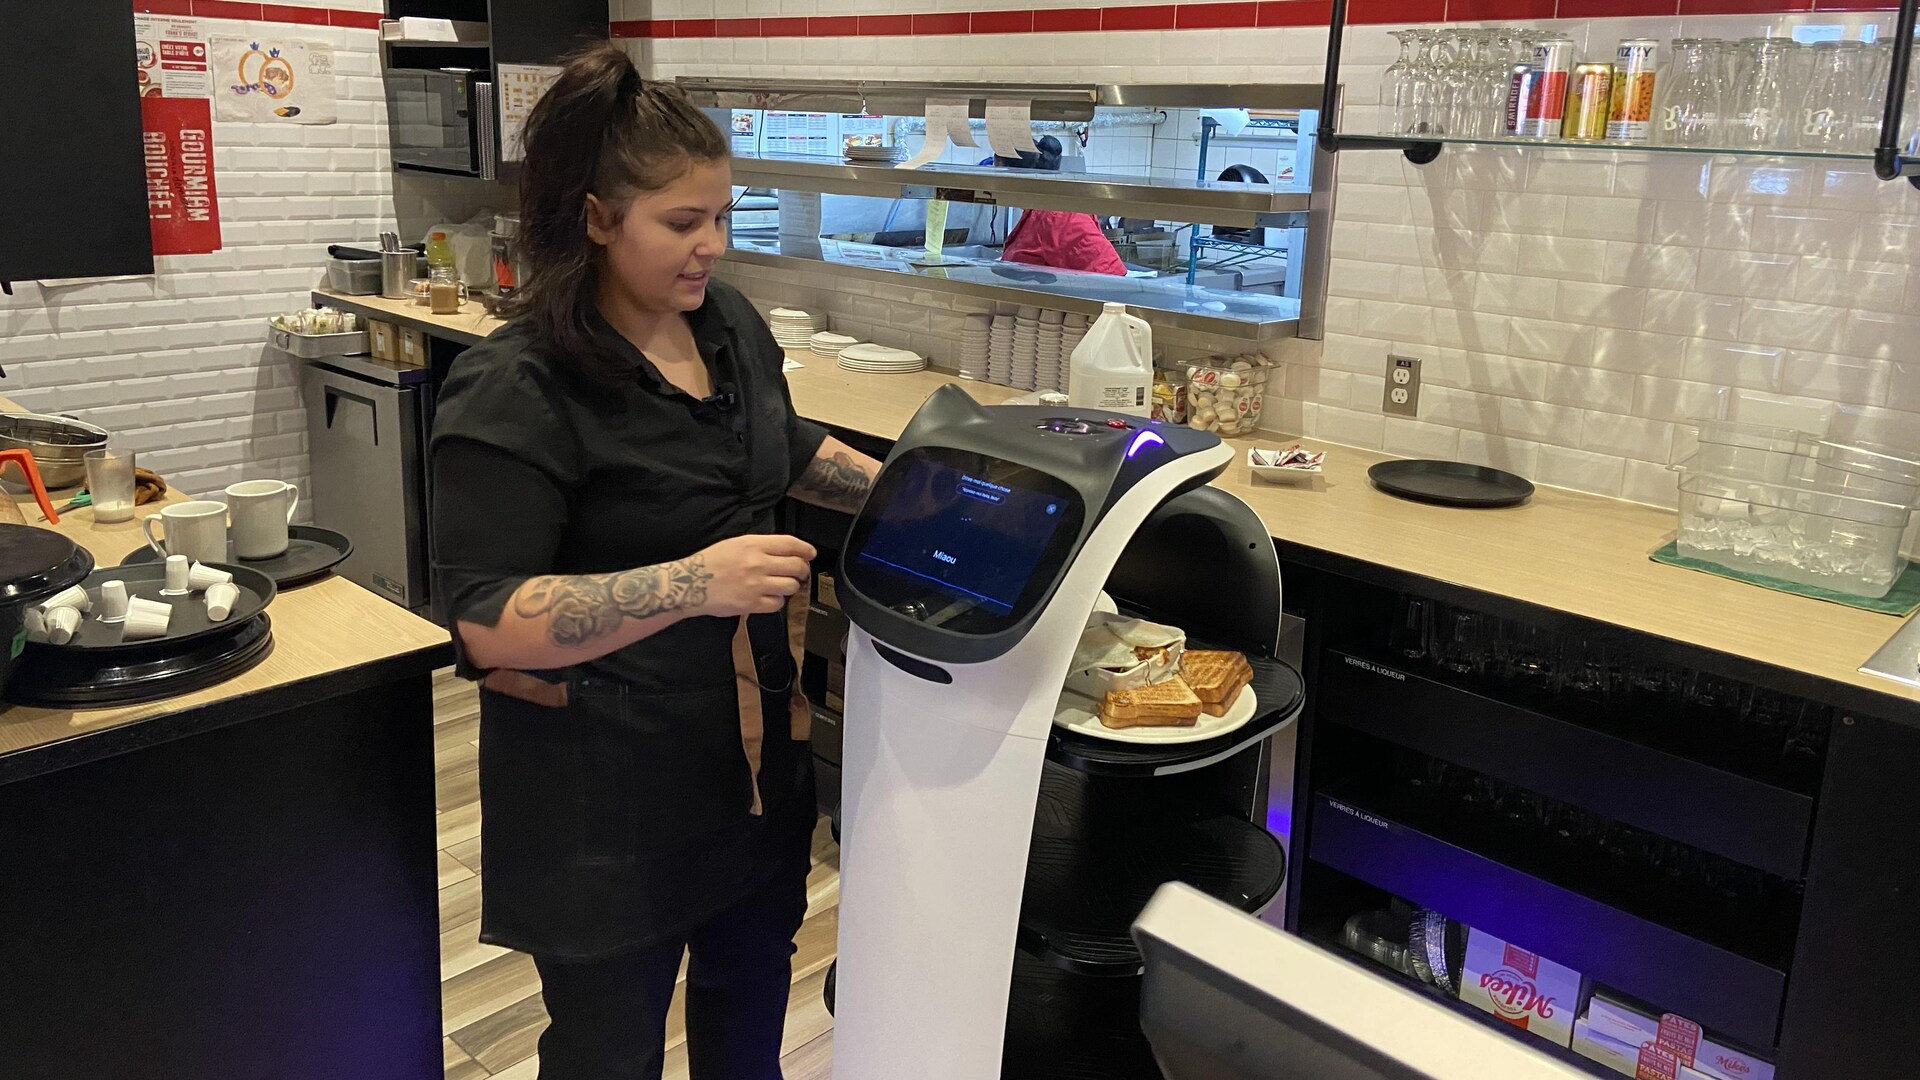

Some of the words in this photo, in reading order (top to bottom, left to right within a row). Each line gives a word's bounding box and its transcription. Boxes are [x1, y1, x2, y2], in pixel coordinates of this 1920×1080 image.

[1507, 78, 1521, 126] SMIRNOFF
[179, 129, 210, 222] GOURMIAM
[932, 549, 957, 565] Miaou
[1344, 656, 1371, 671] VERRES
[1376, 667, 1406, 681] LIQUEUR
[1329, 800, 1355, 816] VERRES
[1360, 813, 1389, 829] LIQUEUR
[1479, 973, 1557, 1019] Mikes
[1659, 1038, 1694, 1055] PASTAS
[1715, 1054, 1751, 1074] Mikes
